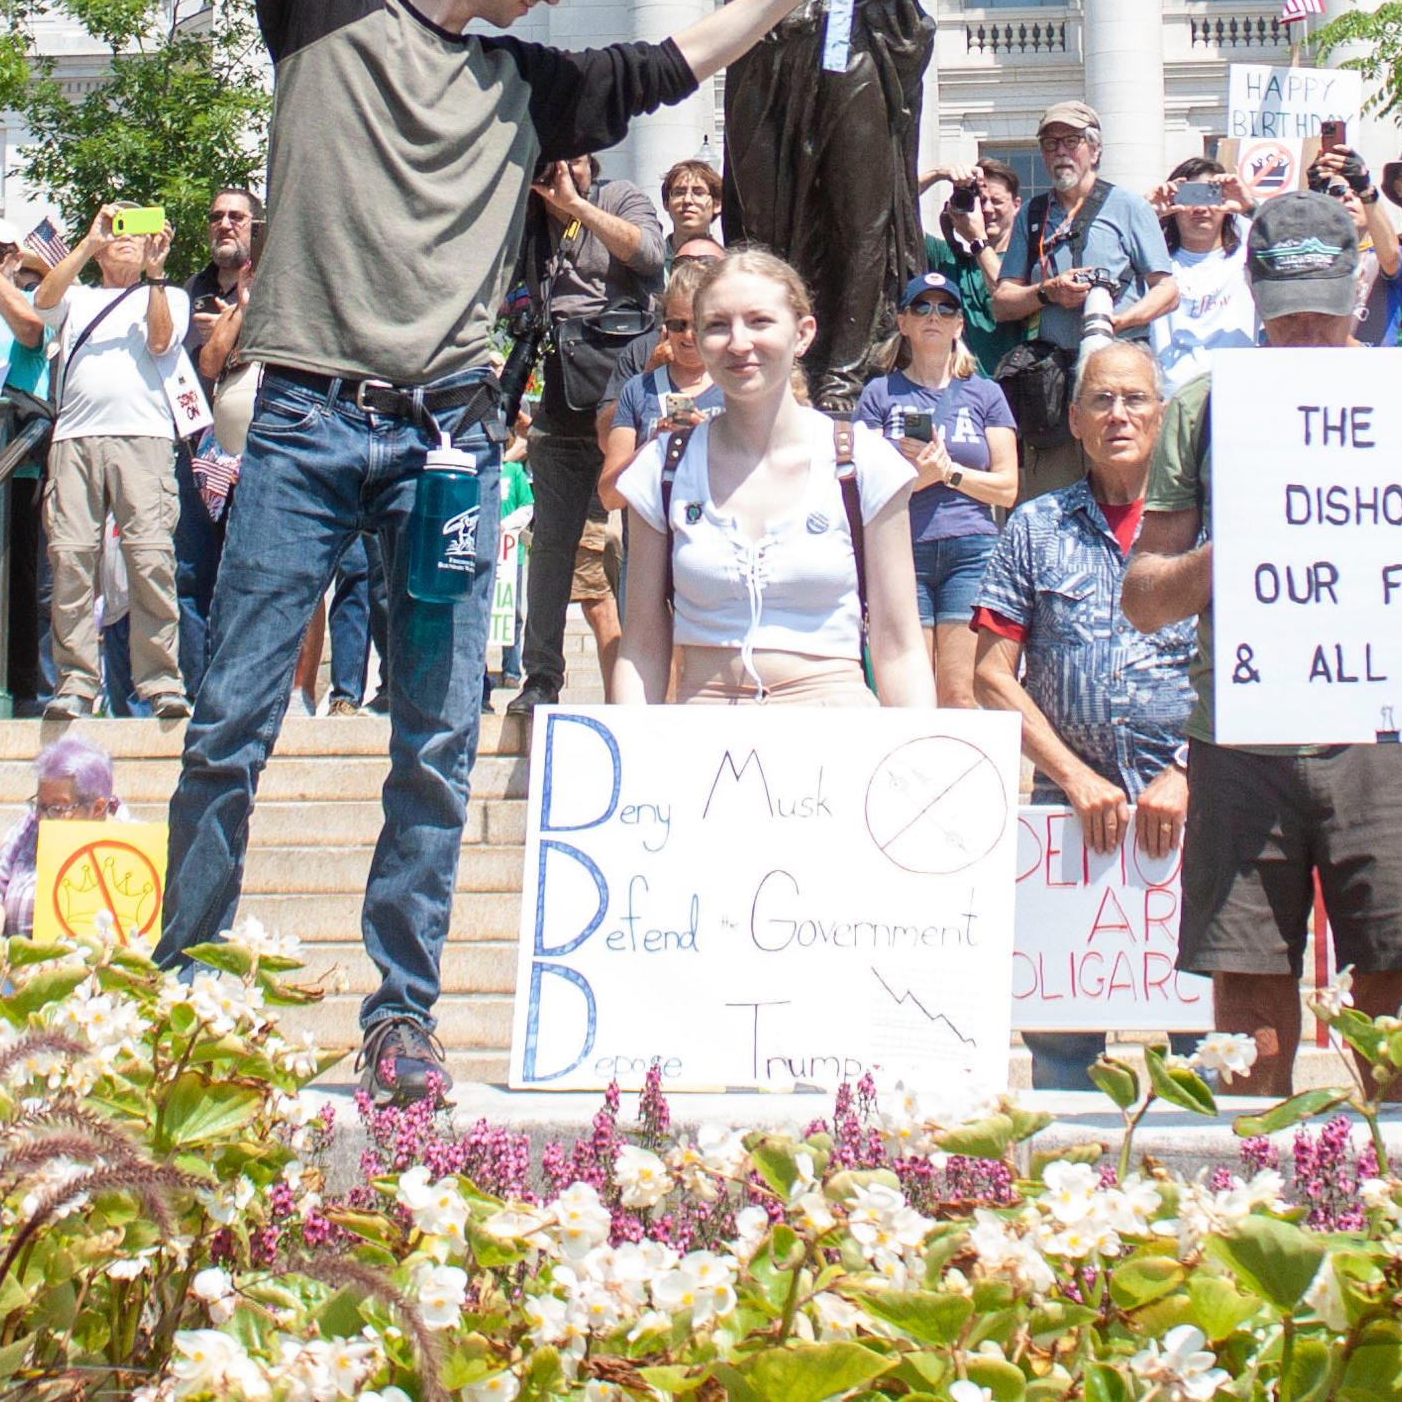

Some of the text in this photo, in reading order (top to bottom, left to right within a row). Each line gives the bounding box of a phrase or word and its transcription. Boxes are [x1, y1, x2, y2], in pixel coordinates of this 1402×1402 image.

[1246, 73, 1335, 102] HAPPY
[1233, 109, 1354, 138] BIRTHD
[890, 404, 982, 444] UA
[1298, 405, 1376, 448] THE
[1254, 562, 1340, 605] OUR
[1231, 643, 1261, 684] &
[1309, 643, 1388, 683] ALL
[540, 713, 833, 852] Deny Musk
[534, 839, 700, 956] Defend
[750, 869, 978, 952] Government
[725, 1000, 863, 1084] Trump
